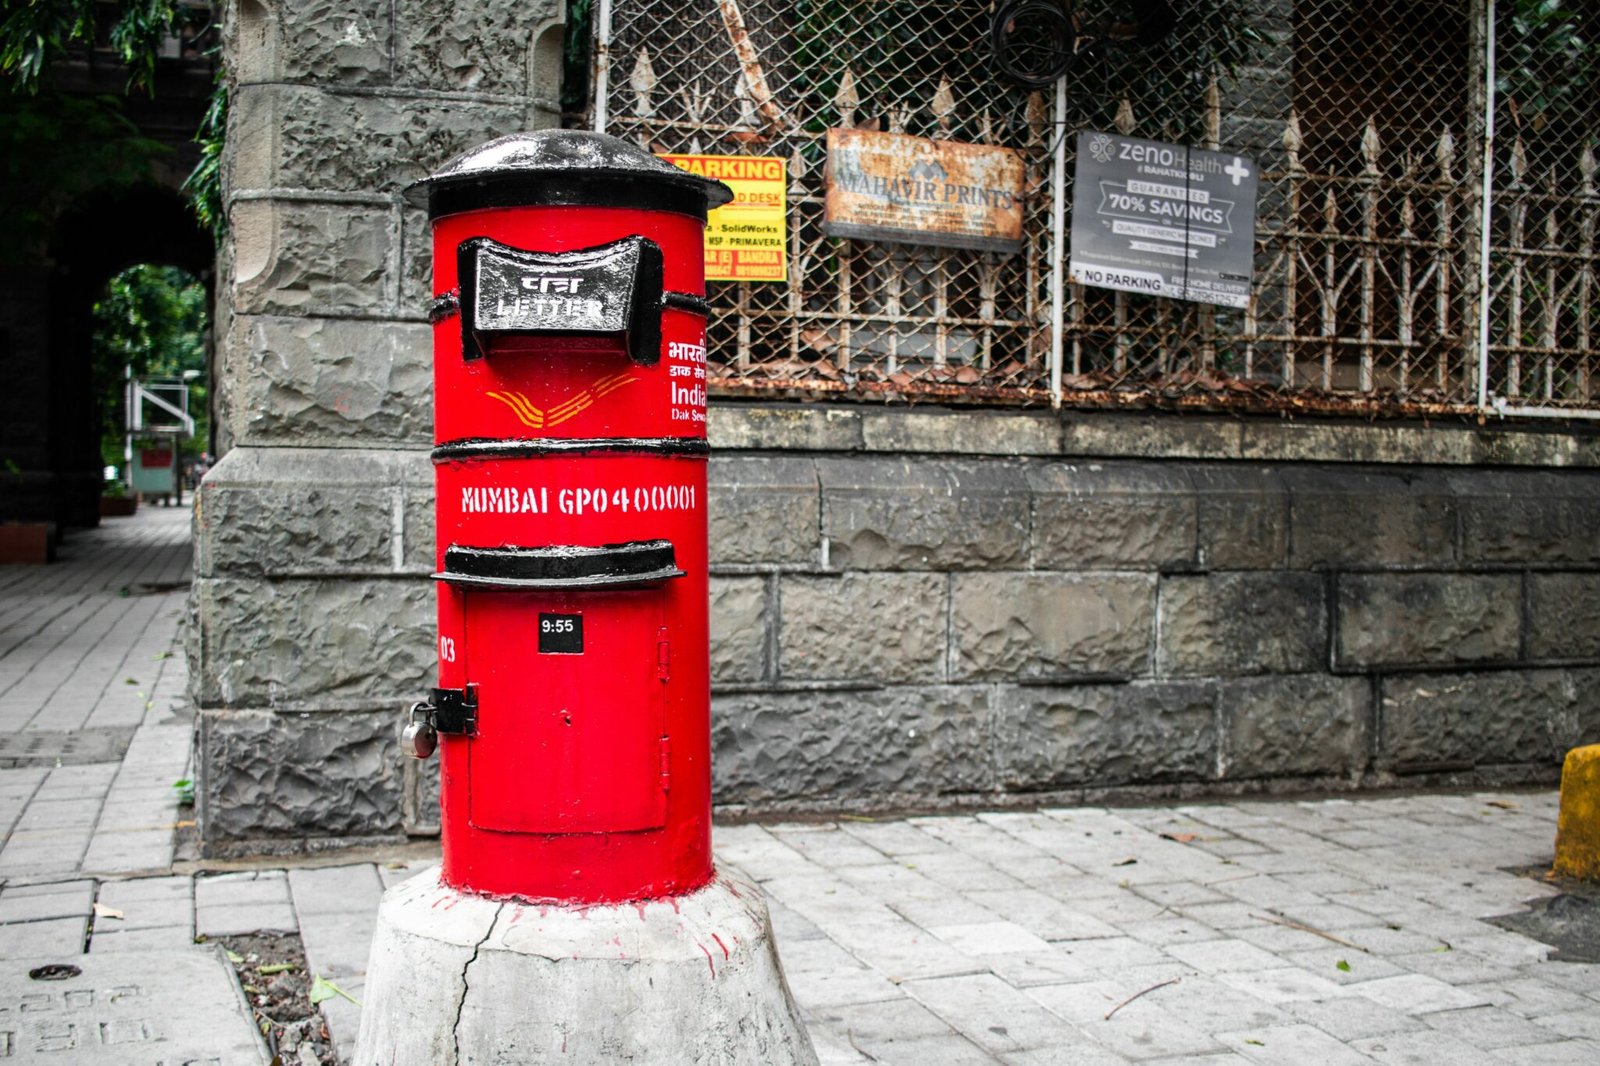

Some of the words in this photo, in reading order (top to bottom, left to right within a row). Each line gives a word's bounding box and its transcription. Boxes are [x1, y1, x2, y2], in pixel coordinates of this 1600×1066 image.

[674, 159, 780, 179] PARKING
[749, 193, 781, 204] DESK
[838, 171, 936, 202] MAHAVIR
[944, 184, 1012, 210] PRINTS
[1131, 182, 1206, 203] GUARANTED
[1109, 193, 1146, 212] 70%
[721, 224, 778, 233] SolidWorks
[730, 238, 782, 246] PRIMAVERA
[1085, 270, 1102, 282] NO
[1106, 273, 1161, 291] PARKING
[497, 299, 604, 318] LETTER
[669, 365, 692, 376] डाक
[671, 381, 706, 406] India
[672, 408, 690, 420] Dak
[461, 487, 547, 513] MUMBAI
[542, 619, 574, 633] 9:55
